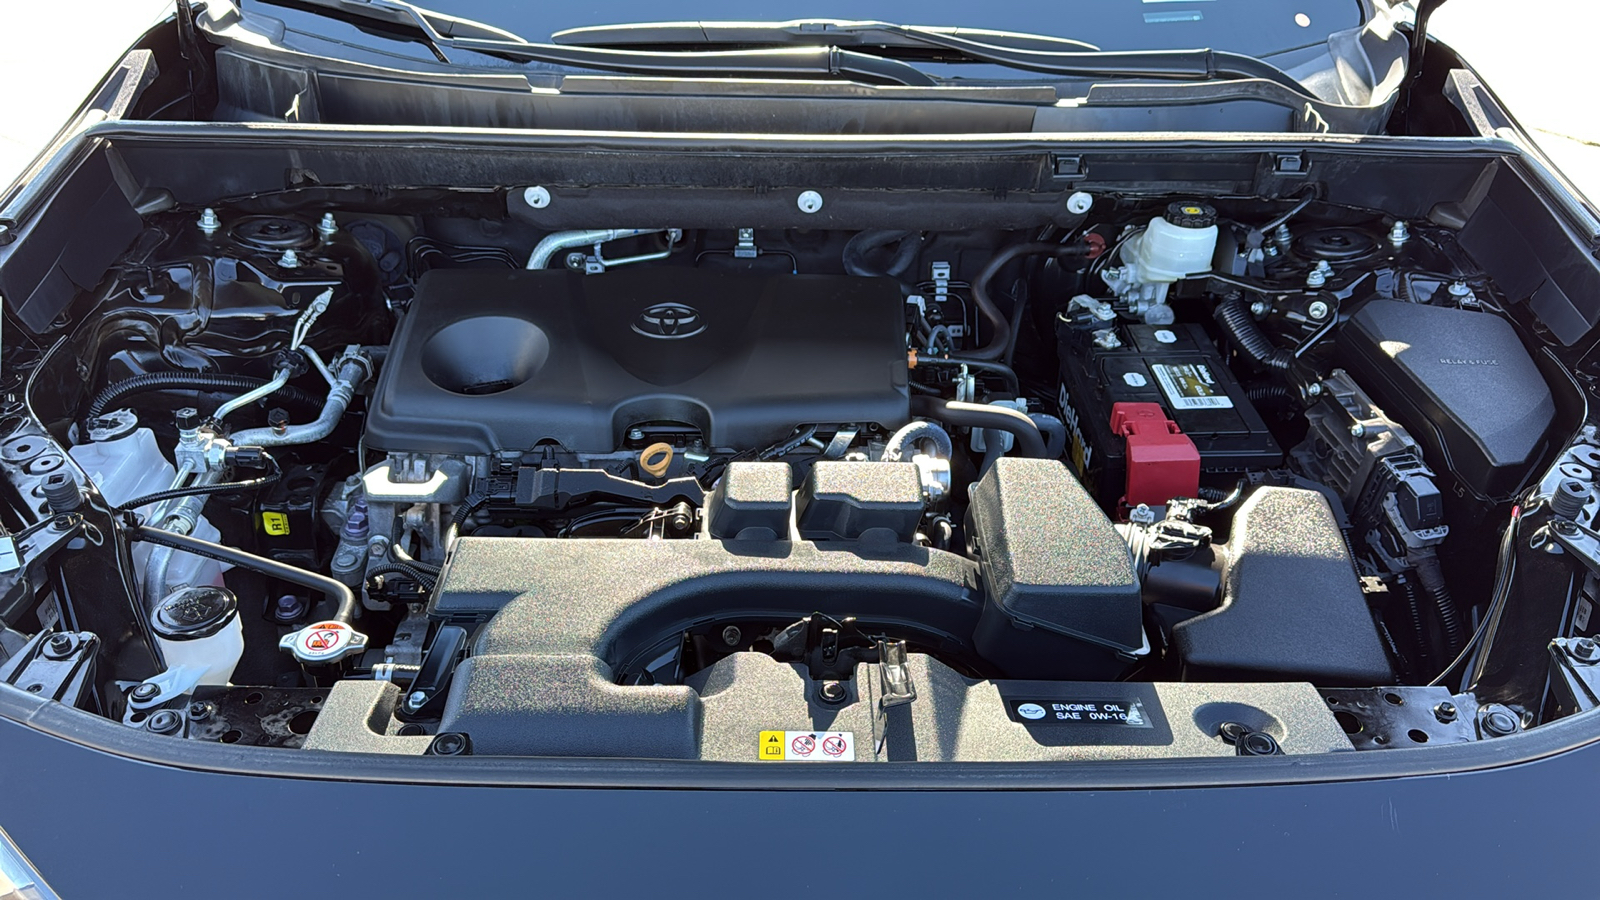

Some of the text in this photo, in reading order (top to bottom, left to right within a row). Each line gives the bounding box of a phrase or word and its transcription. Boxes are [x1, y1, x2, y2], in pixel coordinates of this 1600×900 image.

[1059, 382, 1092, 469] DieHard
[271, 517, 282, 531] R1
[1052, 703, 1125, 712] ENGINE OIL
[1056, 711, 1082, 720] SAE
